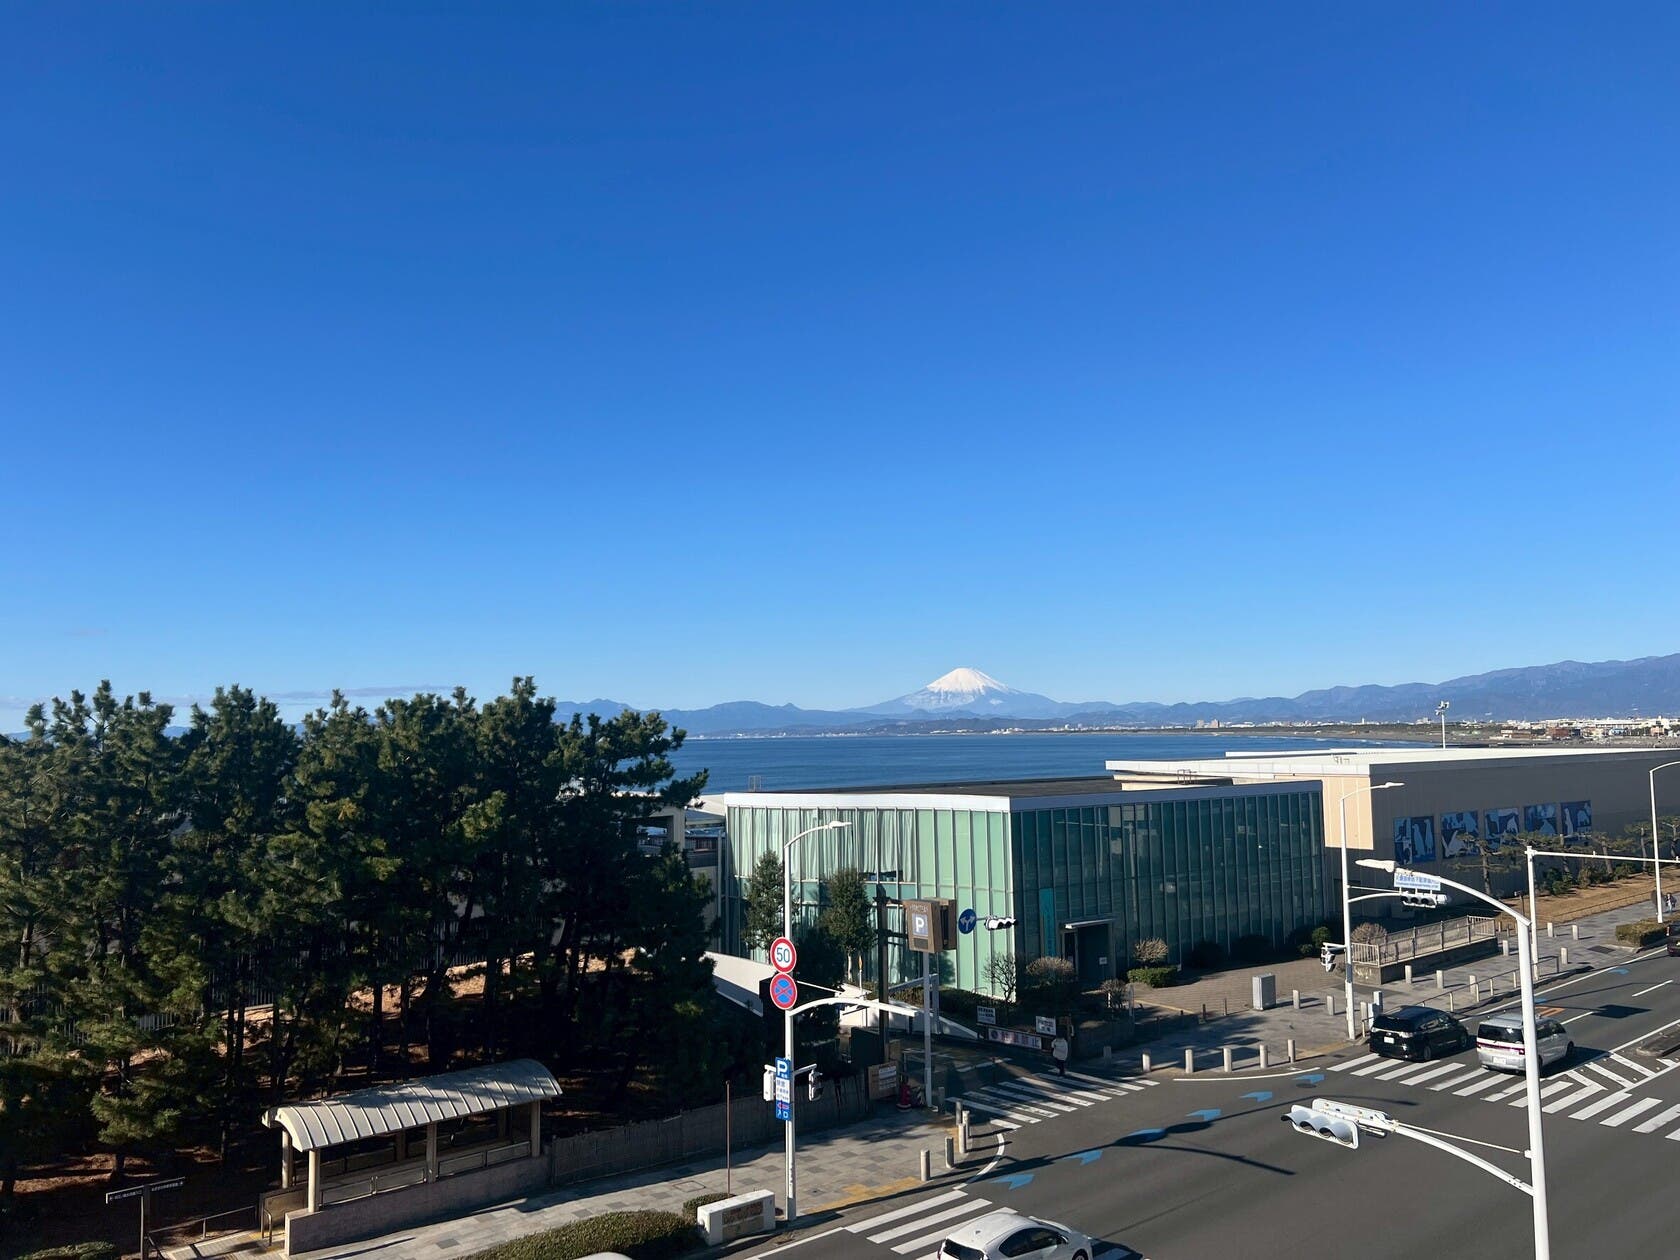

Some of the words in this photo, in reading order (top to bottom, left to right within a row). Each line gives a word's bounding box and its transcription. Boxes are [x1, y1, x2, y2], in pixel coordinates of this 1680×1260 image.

[915, 916, 925, 933] P
[776, 947, 790, 963] 50
[777, 1059, 788, 1077] P
